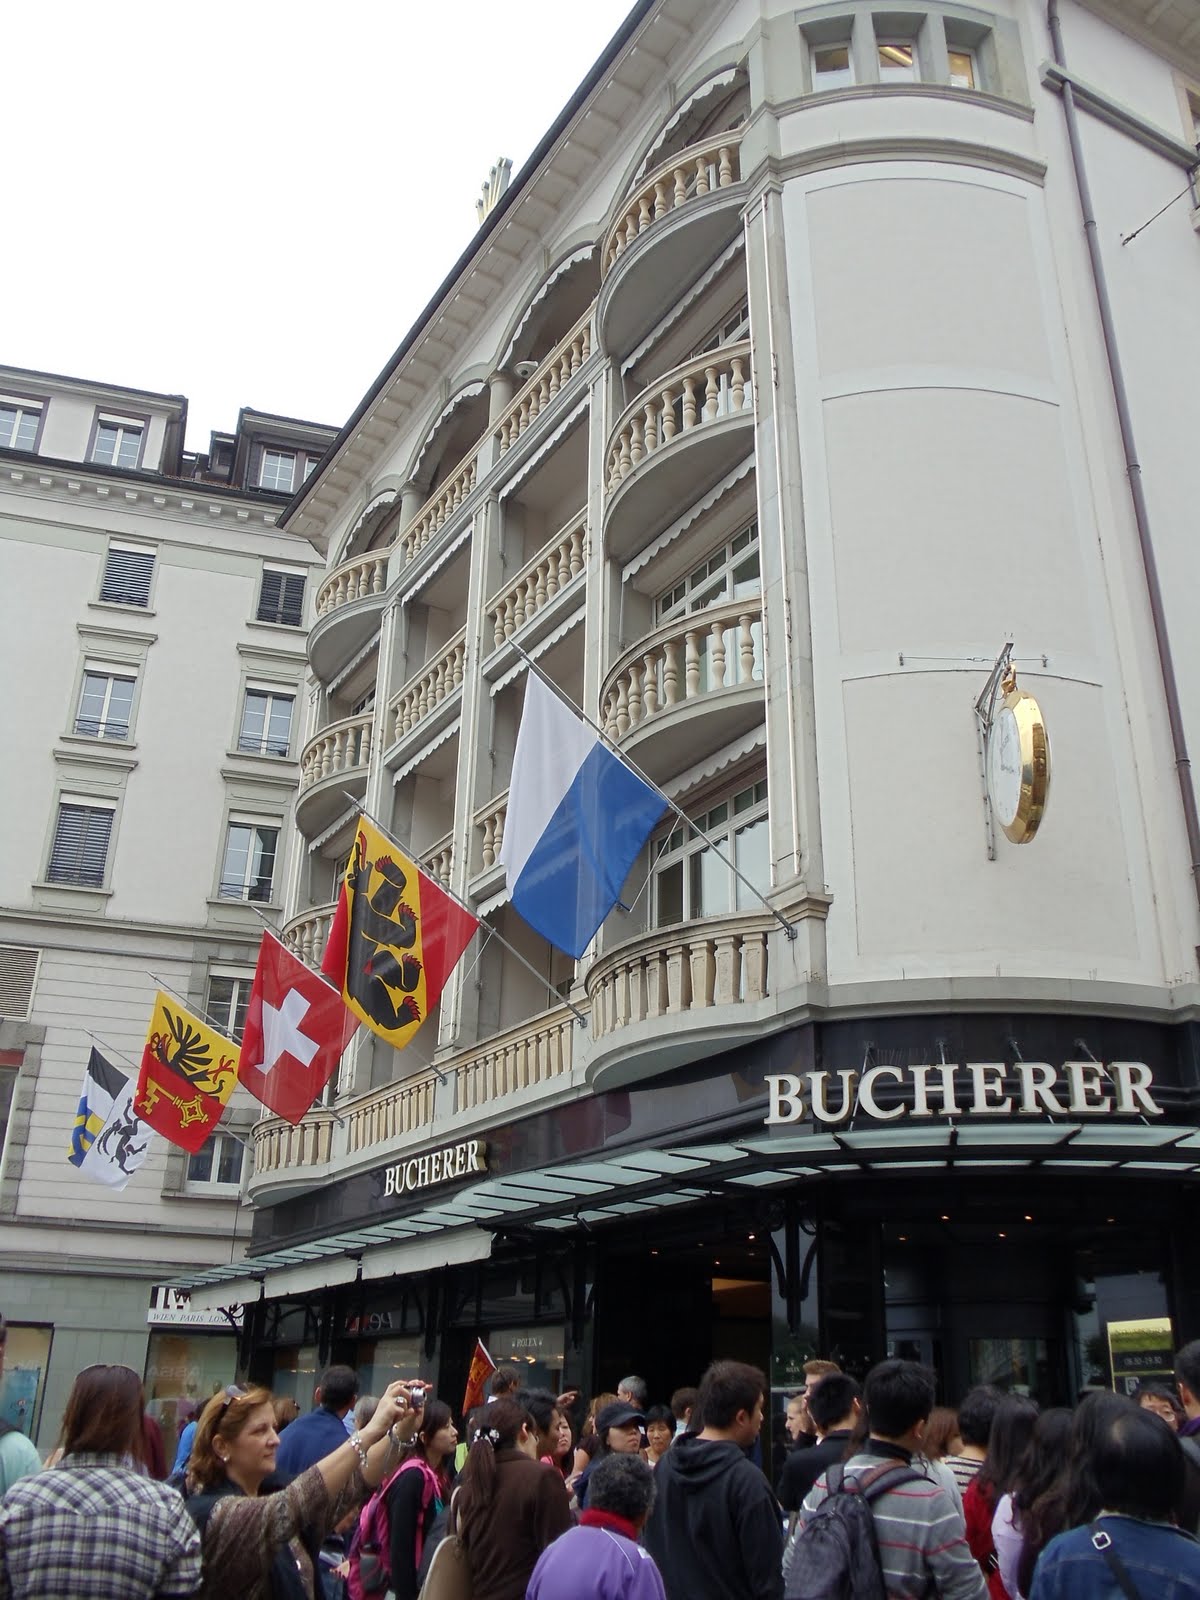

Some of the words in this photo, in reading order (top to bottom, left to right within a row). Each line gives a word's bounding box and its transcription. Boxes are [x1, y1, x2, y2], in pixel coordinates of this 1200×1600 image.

[763, 1061, 1164, 1125] BUCHERER
[383, 1139, 483, 1197] BUCHERER
[153, 1313, 176, 1321] WIEN
[180, 1314, 204, 1322] PARIS
[208, 1315, 243, 1324] LONN
